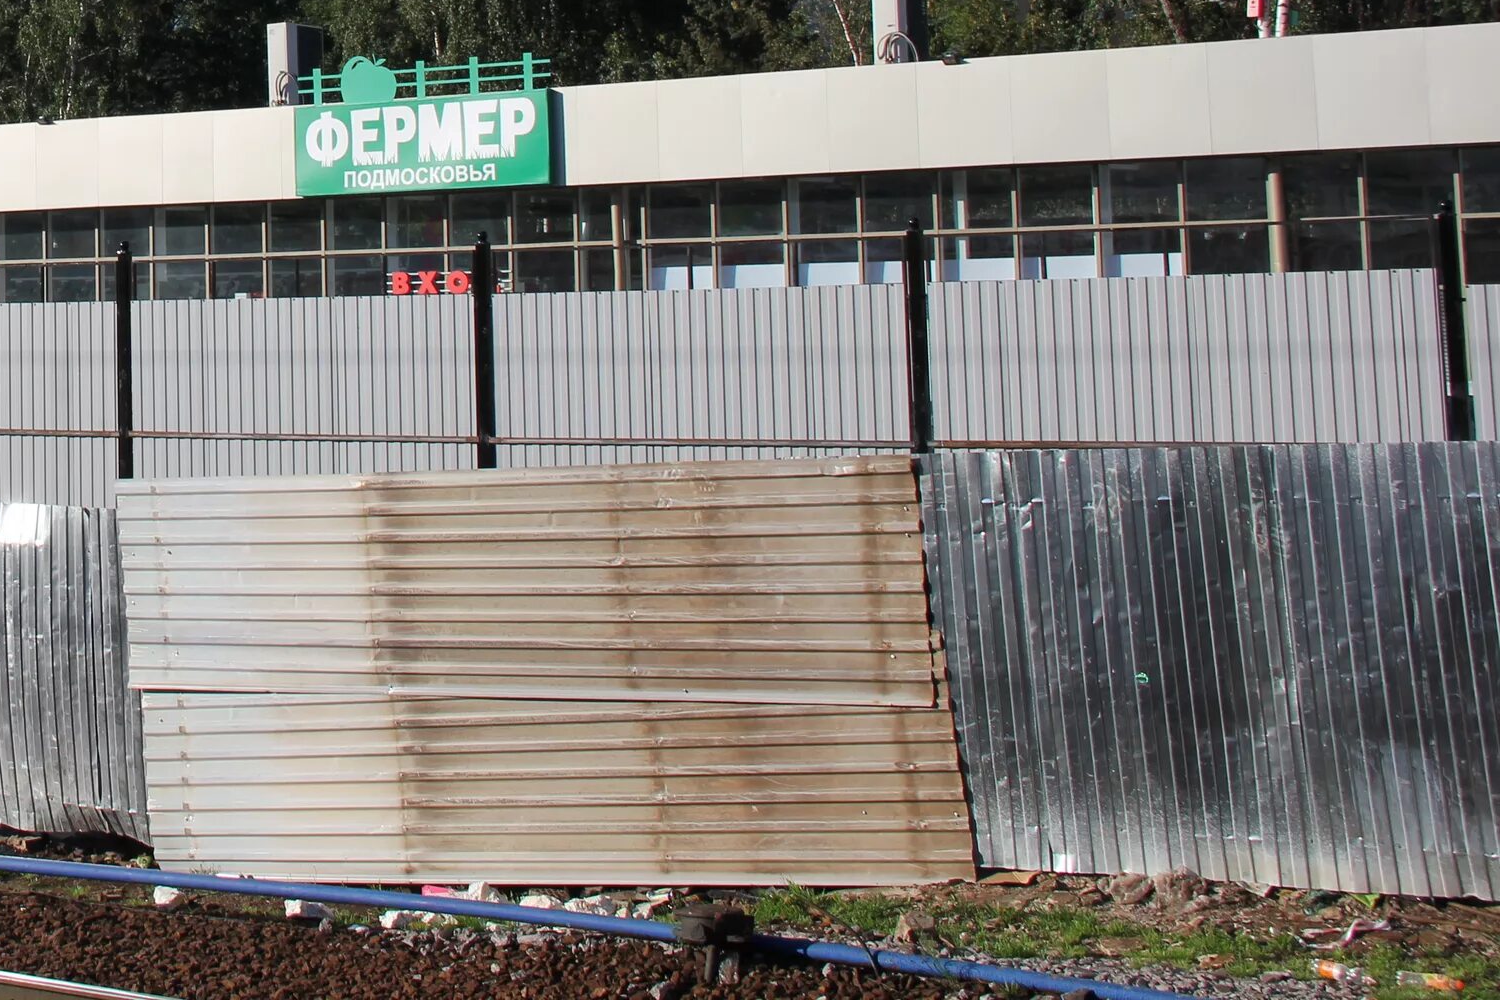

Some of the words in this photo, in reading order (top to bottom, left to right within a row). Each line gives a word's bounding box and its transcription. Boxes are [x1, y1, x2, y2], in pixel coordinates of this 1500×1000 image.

[305, 96, 536, 168] ФЕРМЕР
[343, 163, 496, 190] ПОДМОСКОВЬЯ
[392, 270, 500, 295] ВХО
